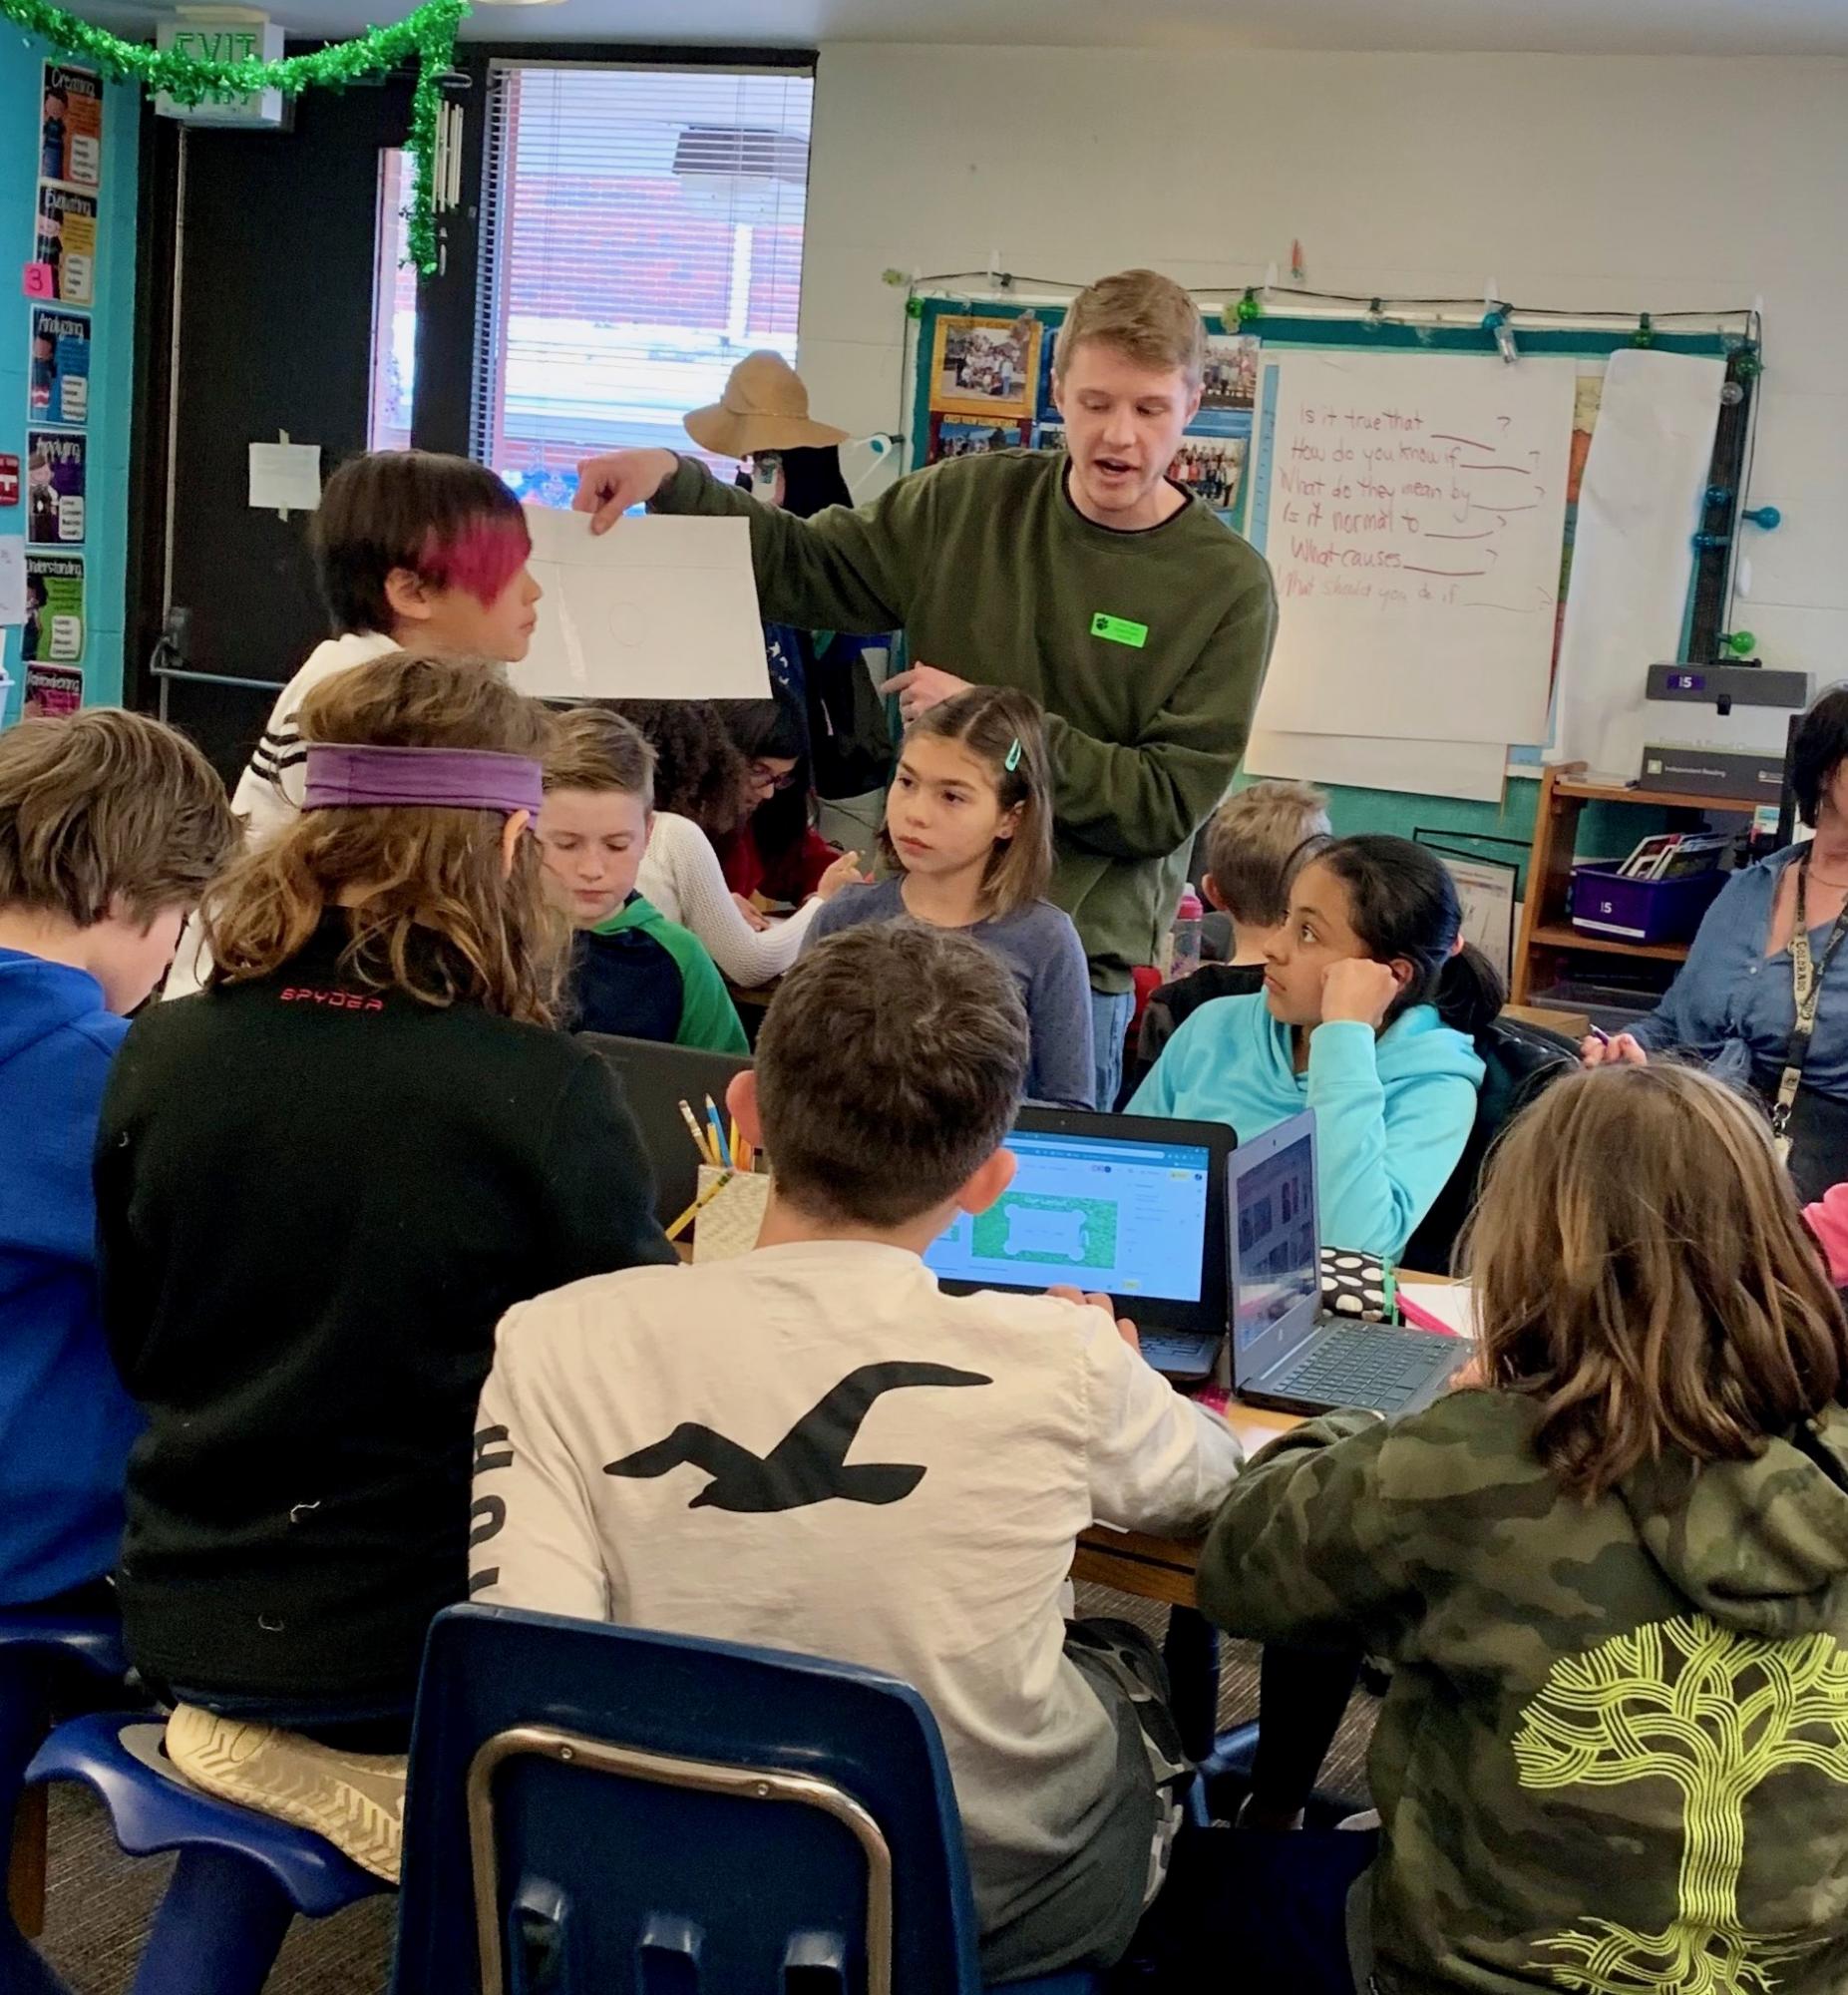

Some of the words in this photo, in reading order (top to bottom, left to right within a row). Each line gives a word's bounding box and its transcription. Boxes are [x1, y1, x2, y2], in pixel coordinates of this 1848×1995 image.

[27, 268, 44, 291] 3
[1299, 403, 1315, 424] Is
[1322, 403, 1337, 426] it
[1344, 408, 1381, 430] true
[1382, 408, 1424, 431] that
[1292, 436, 1325, 462] How
[1332, 436, 1354, 462] do
[1363, 447, 1395, 472] you
[1399, 440, 1438, 465] know
[1445, 447, 1461, 469] if
[1279, 465, 1324, 496] What
[1331, 474, 1351, 500] do
[1356, 476, 1395, 501] they
[1400, 482, 1442, 500] mean
[1451, 475, 1470, 524] by
[1307, 502, 1323, 528] it
[1332, 503, 1394, 535] normal
[1400, 510, 1420, 534] to
[1291, 536, 1341, 568] What
[1341, 549, 1402, 569] causes
[279, 988, 383, 1011] SPYDER
